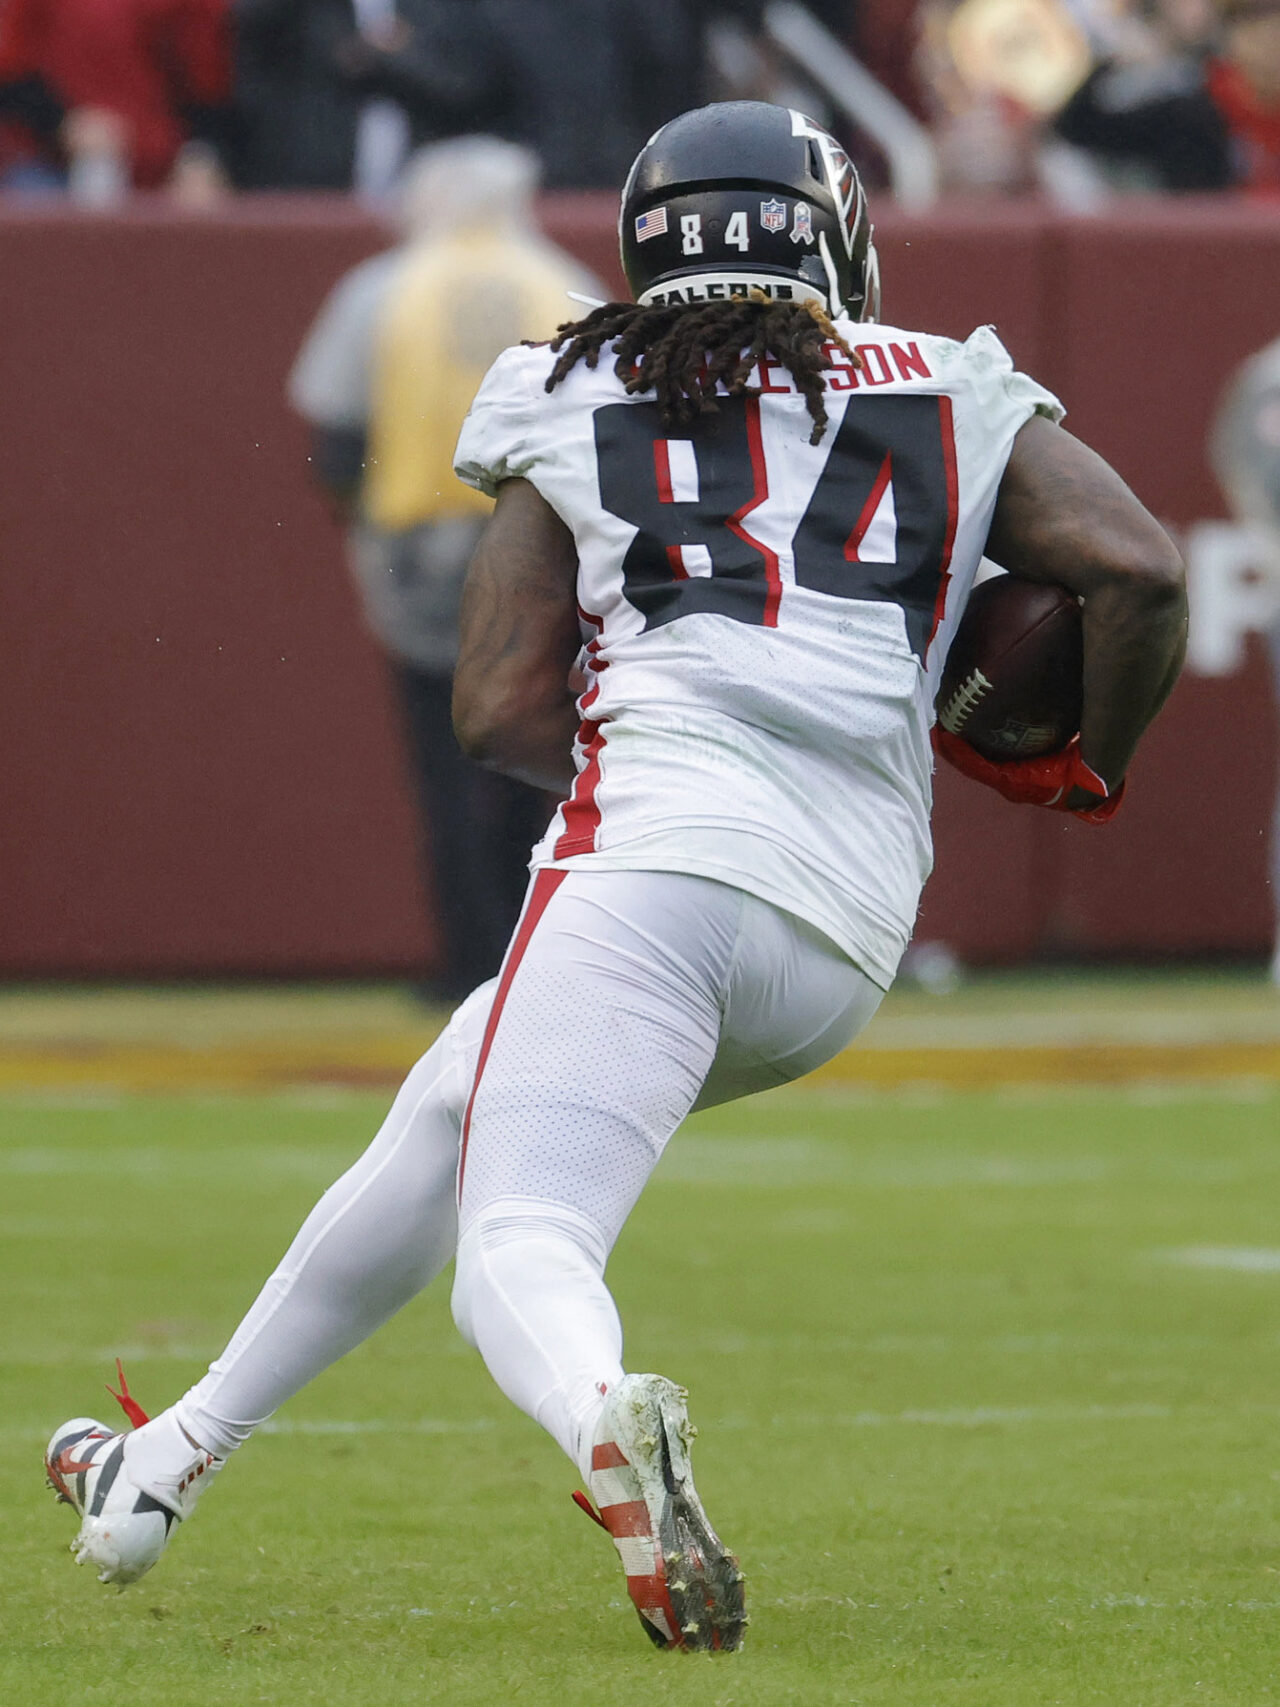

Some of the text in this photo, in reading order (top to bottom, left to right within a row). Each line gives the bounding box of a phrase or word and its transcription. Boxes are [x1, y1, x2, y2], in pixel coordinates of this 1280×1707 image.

[764, 213, 783, 228] NFL
[651, 283, 793, 305] FALCONS
[593, 394, 959, 668] 84
